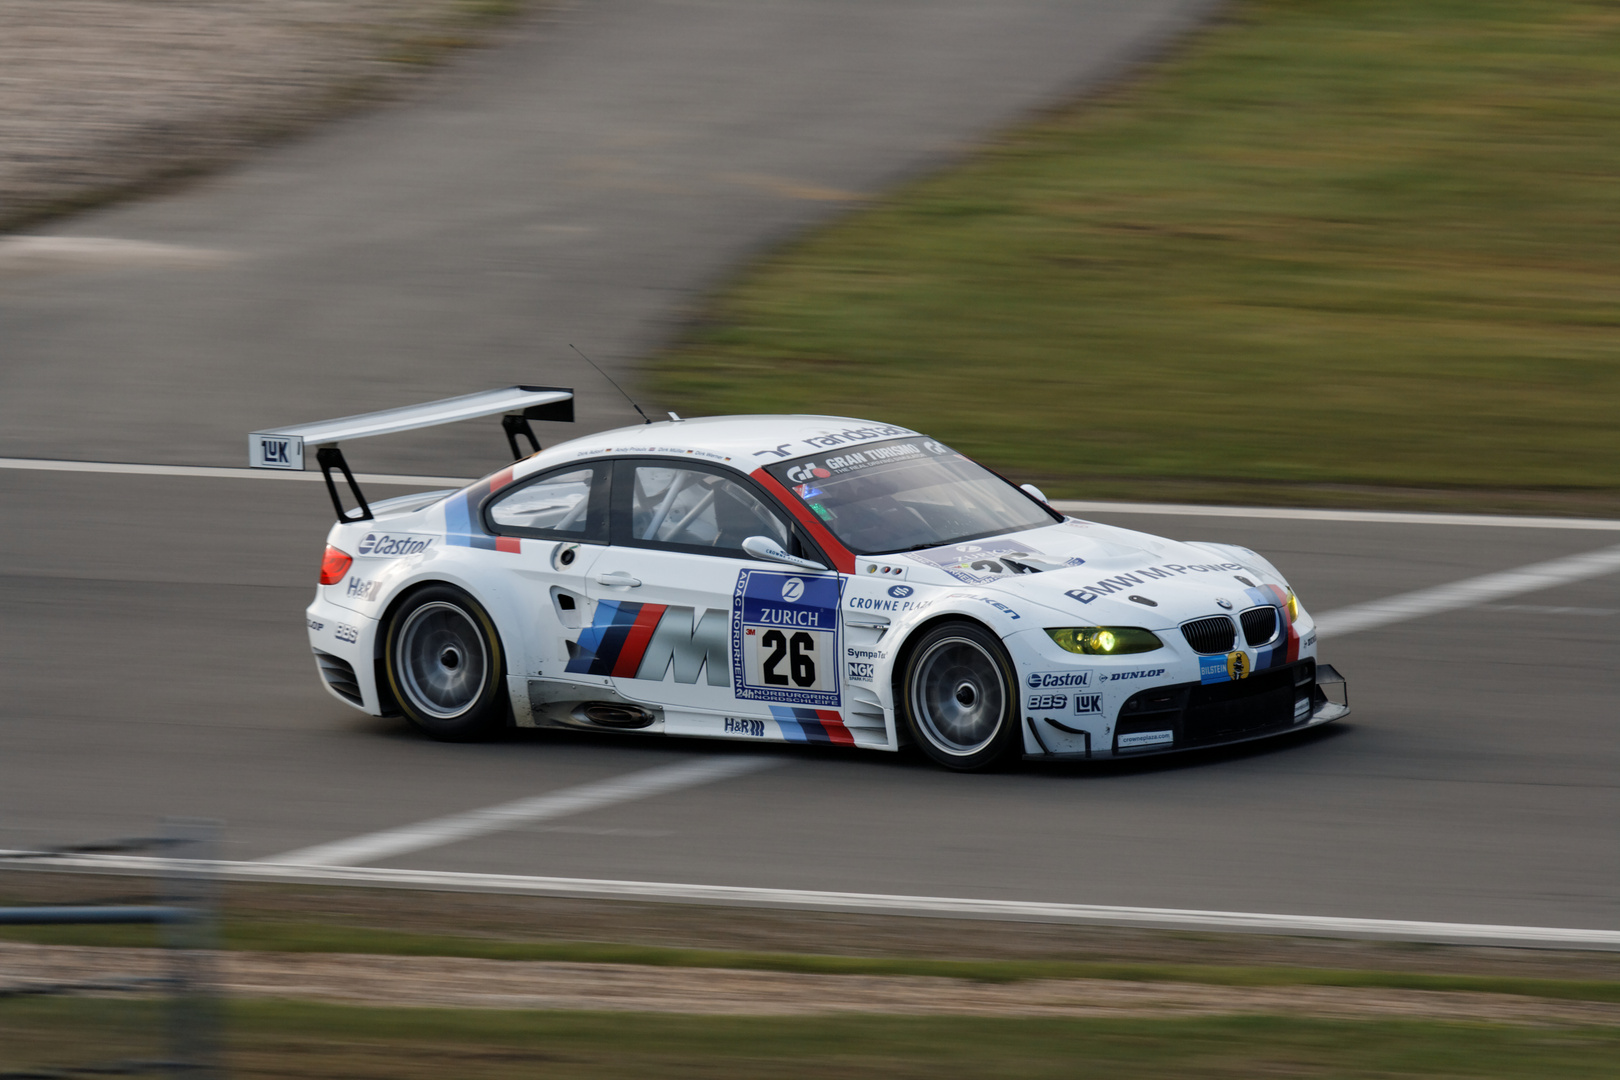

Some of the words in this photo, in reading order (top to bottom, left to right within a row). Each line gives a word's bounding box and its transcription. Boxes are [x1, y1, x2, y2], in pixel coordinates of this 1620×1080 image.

[825, 452, 868, 470] GRAN
[864, 443, 921, 460] TURISMO
[833, 466, 849, 474] THE
[850, 463, 868, 472] REAL
[373, 535, 433, 555] Castrol
[734, 571, 747, 607] ADAC
[1064, 573, 1145, 605] BMW
[1135, 566, 1174, 580] M
[849, 597, 899, 612] CROWNE
[901, 600, 933, 612] PLAZA
[760, 608, 819, 627] ZURICH
[334, 621, 358, 644] BBS
[745, 628, 756, 636] 3M
[733, 610, 743, 688] NORDRHEIN
[762, 629, 816, 688] 26
[848, 663, 874, 678] NGK
[1110, 669, 1165, 681] DUNLOP
[1200, 664, 1227, 676] BILSTEIN
[1042, 672, 1089, 688] Castrol
[736, 688, 754, 699] 24h
[754, 695, 839, 706] NORDSCHLEIFE
[1027, 694, 1067, 710] BBS
[725, 717, 749, 734] H&R
[1122, 733, 1171, 744] crowneplaza.com
